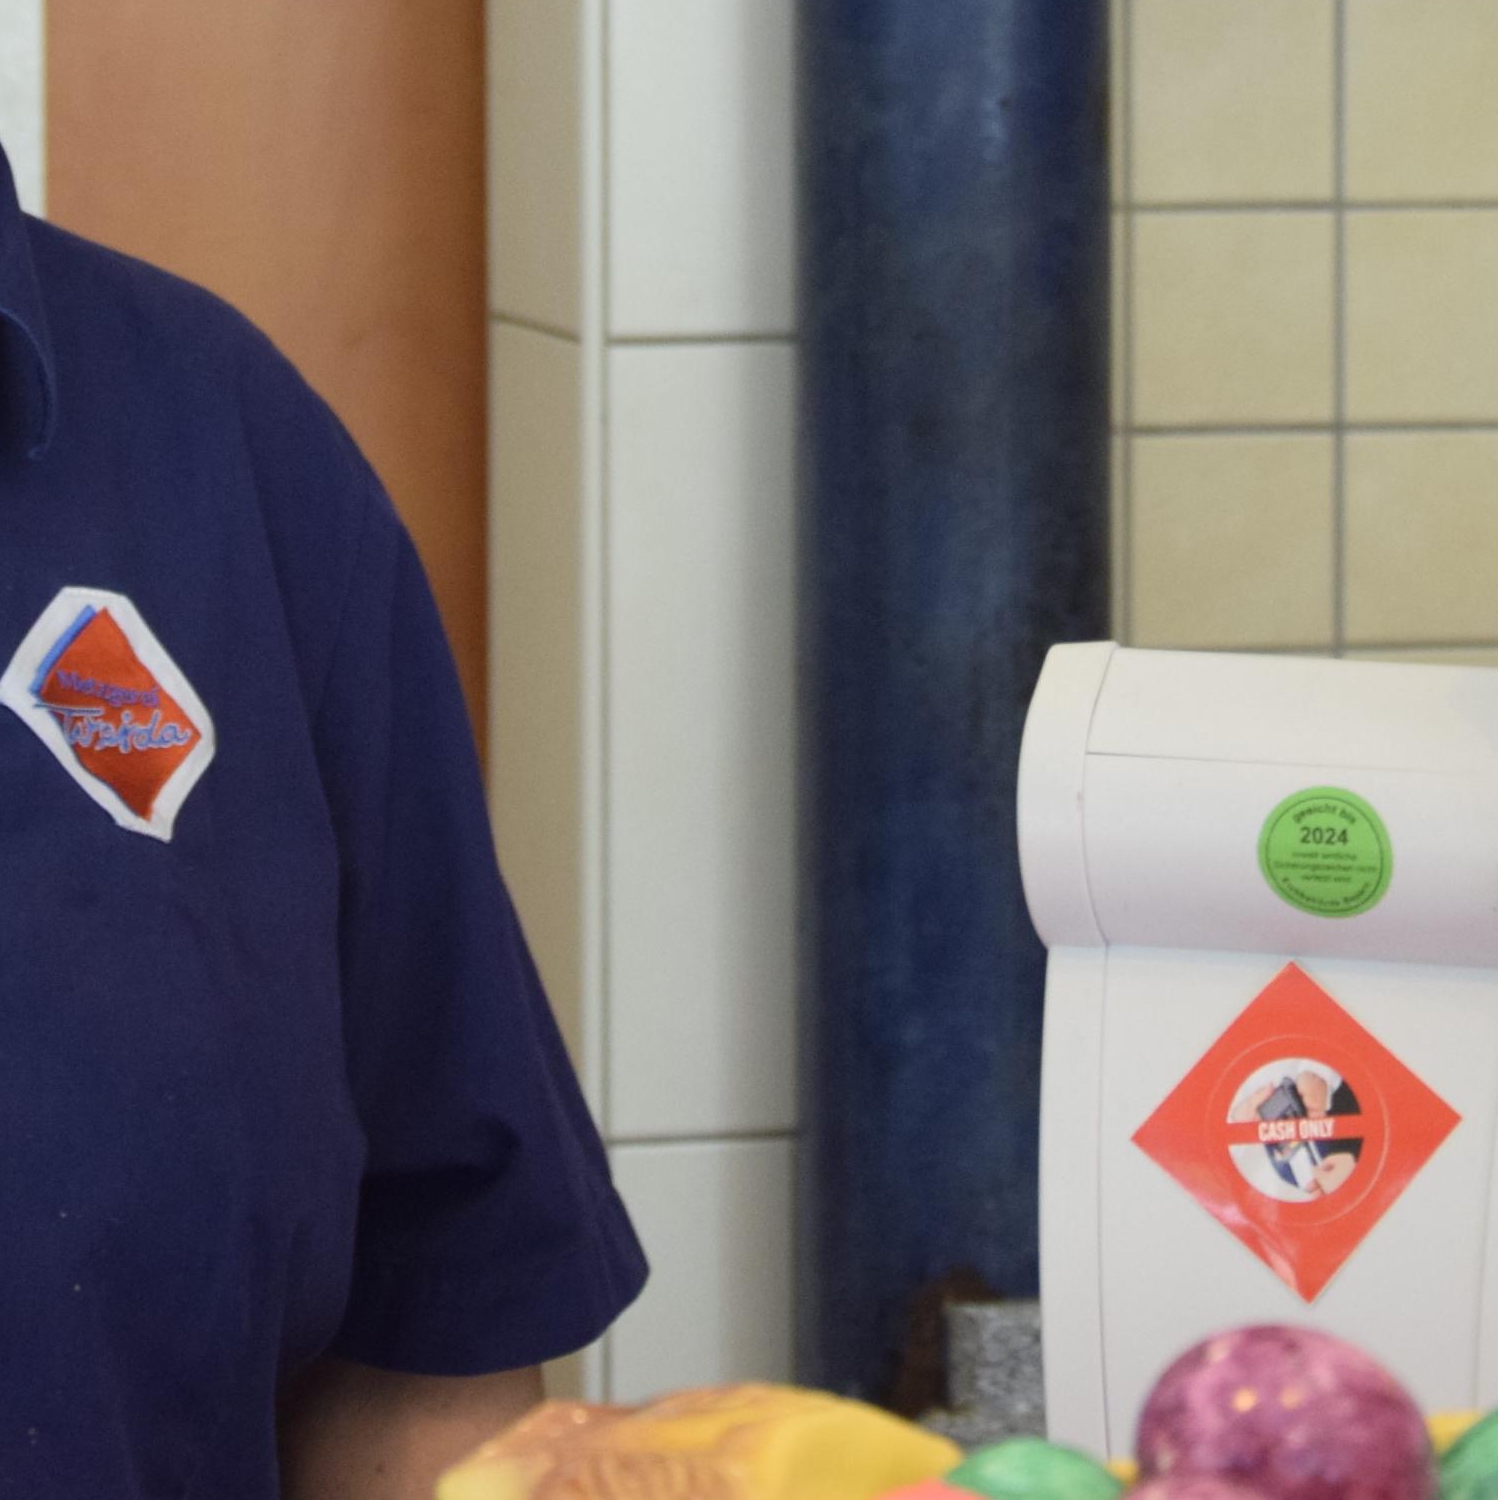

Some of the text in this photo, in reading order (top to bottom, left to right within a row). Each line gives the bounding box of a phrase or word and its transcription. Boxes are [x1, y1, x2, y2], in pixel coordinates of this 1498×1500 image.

[1300, 826, 1349, 846] 2024
[1257, 1117, 1334, 1142] CASH ONLY
